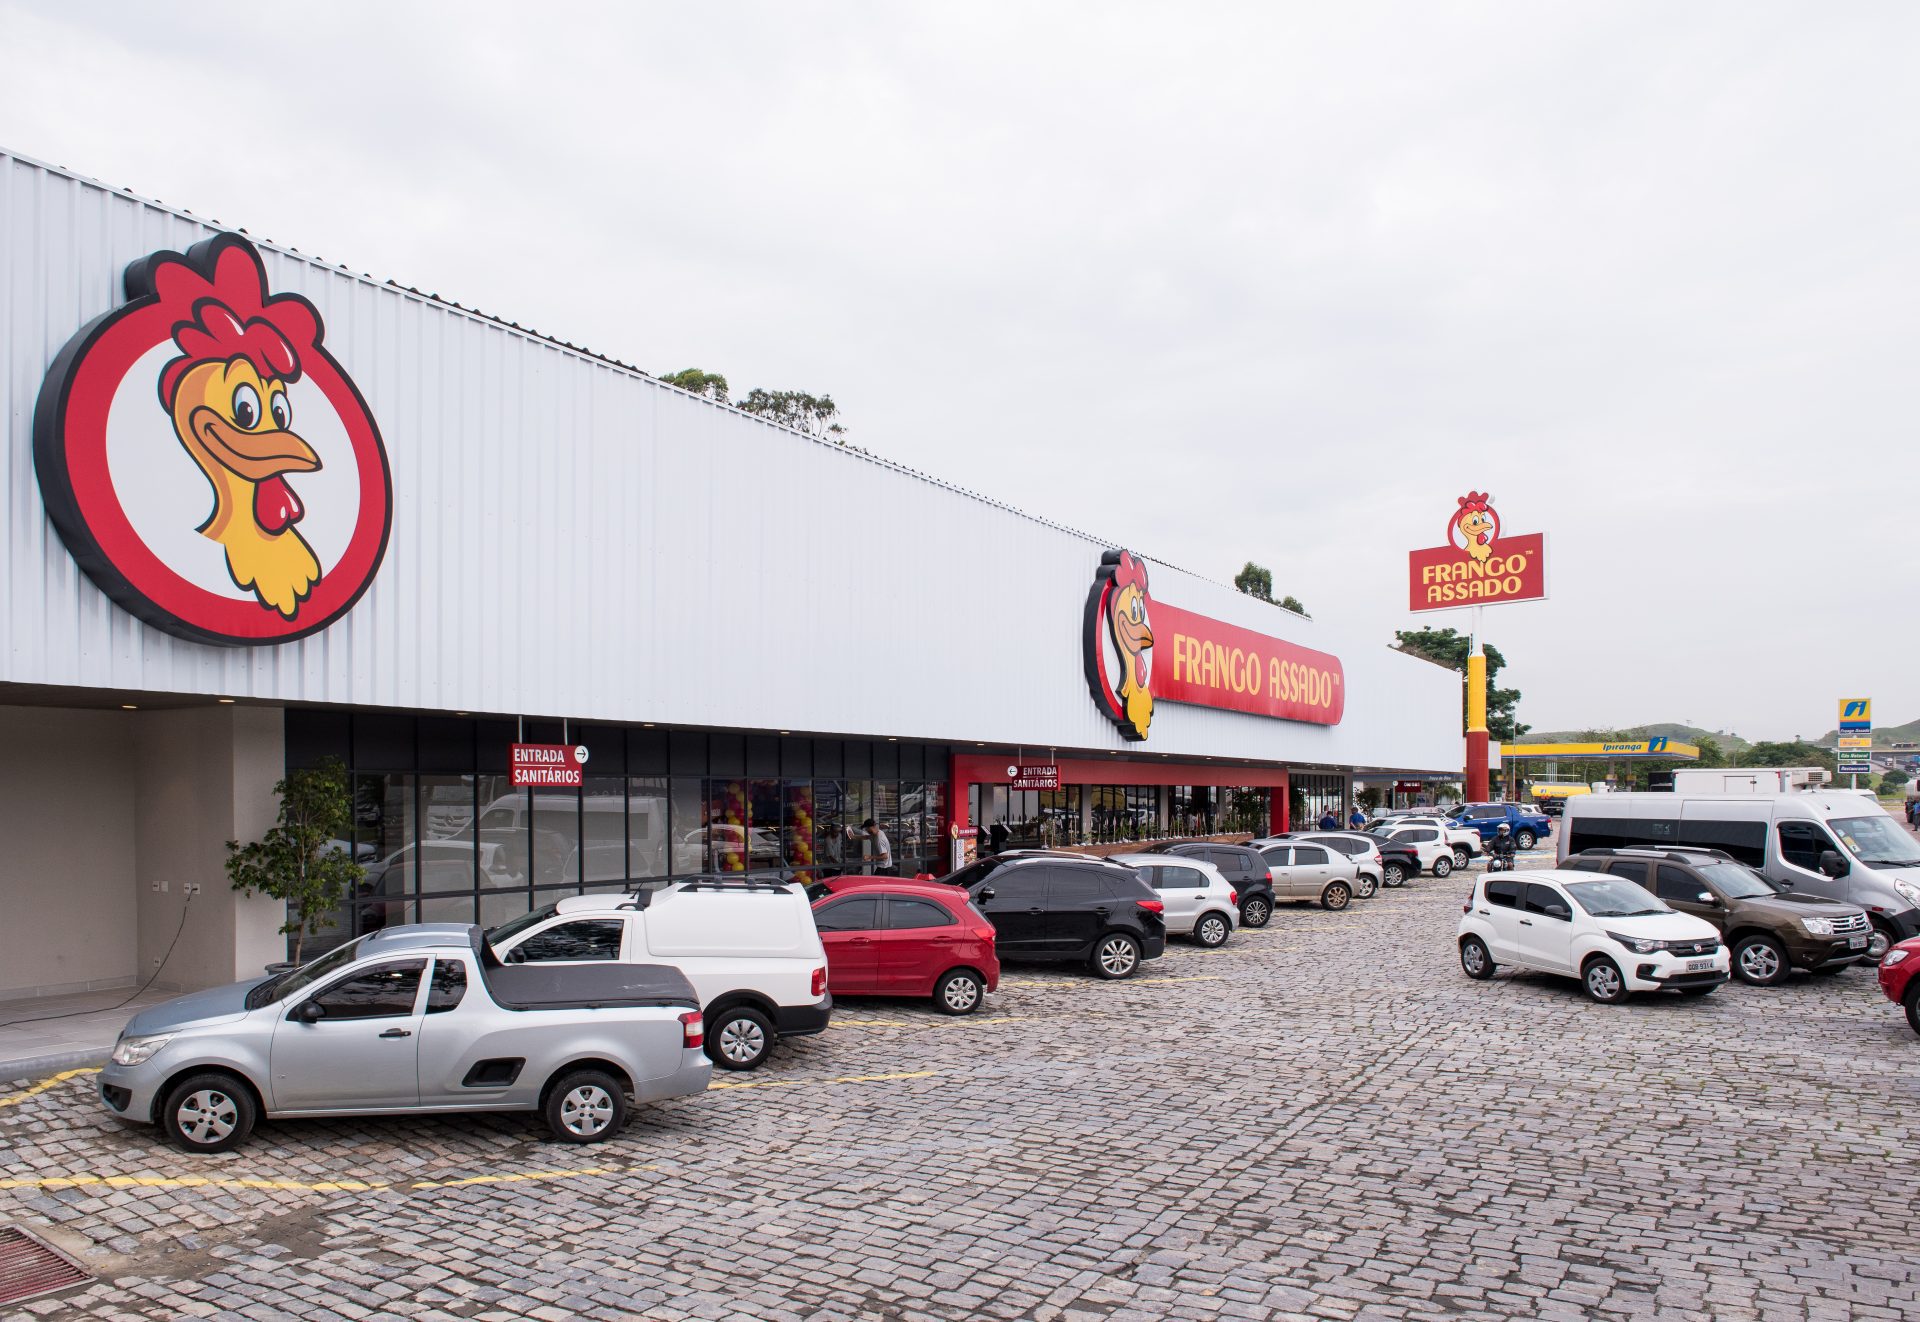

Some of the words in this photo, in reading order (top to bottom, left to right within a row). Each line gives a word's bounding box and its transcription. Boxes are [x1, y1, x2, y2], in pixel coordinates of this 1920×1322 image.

[1423, 554, 1527, 584] FRANGO
[1427, 576, 1522, 603] ASSADO
[1173, 633, 1262, 696] FRANGO
[1269, 656, 1332, 708] ASSADO
[1602, 743, 1642, 751] Ipiranga
[514, 748, 565, 763] ENTRADA
[514, 767, 580, 783] SANITÁRIOS
[1023, 767, 1058, 776] ENTRADA
[1013, 777, 1058, 788] SANITÁRIOS
